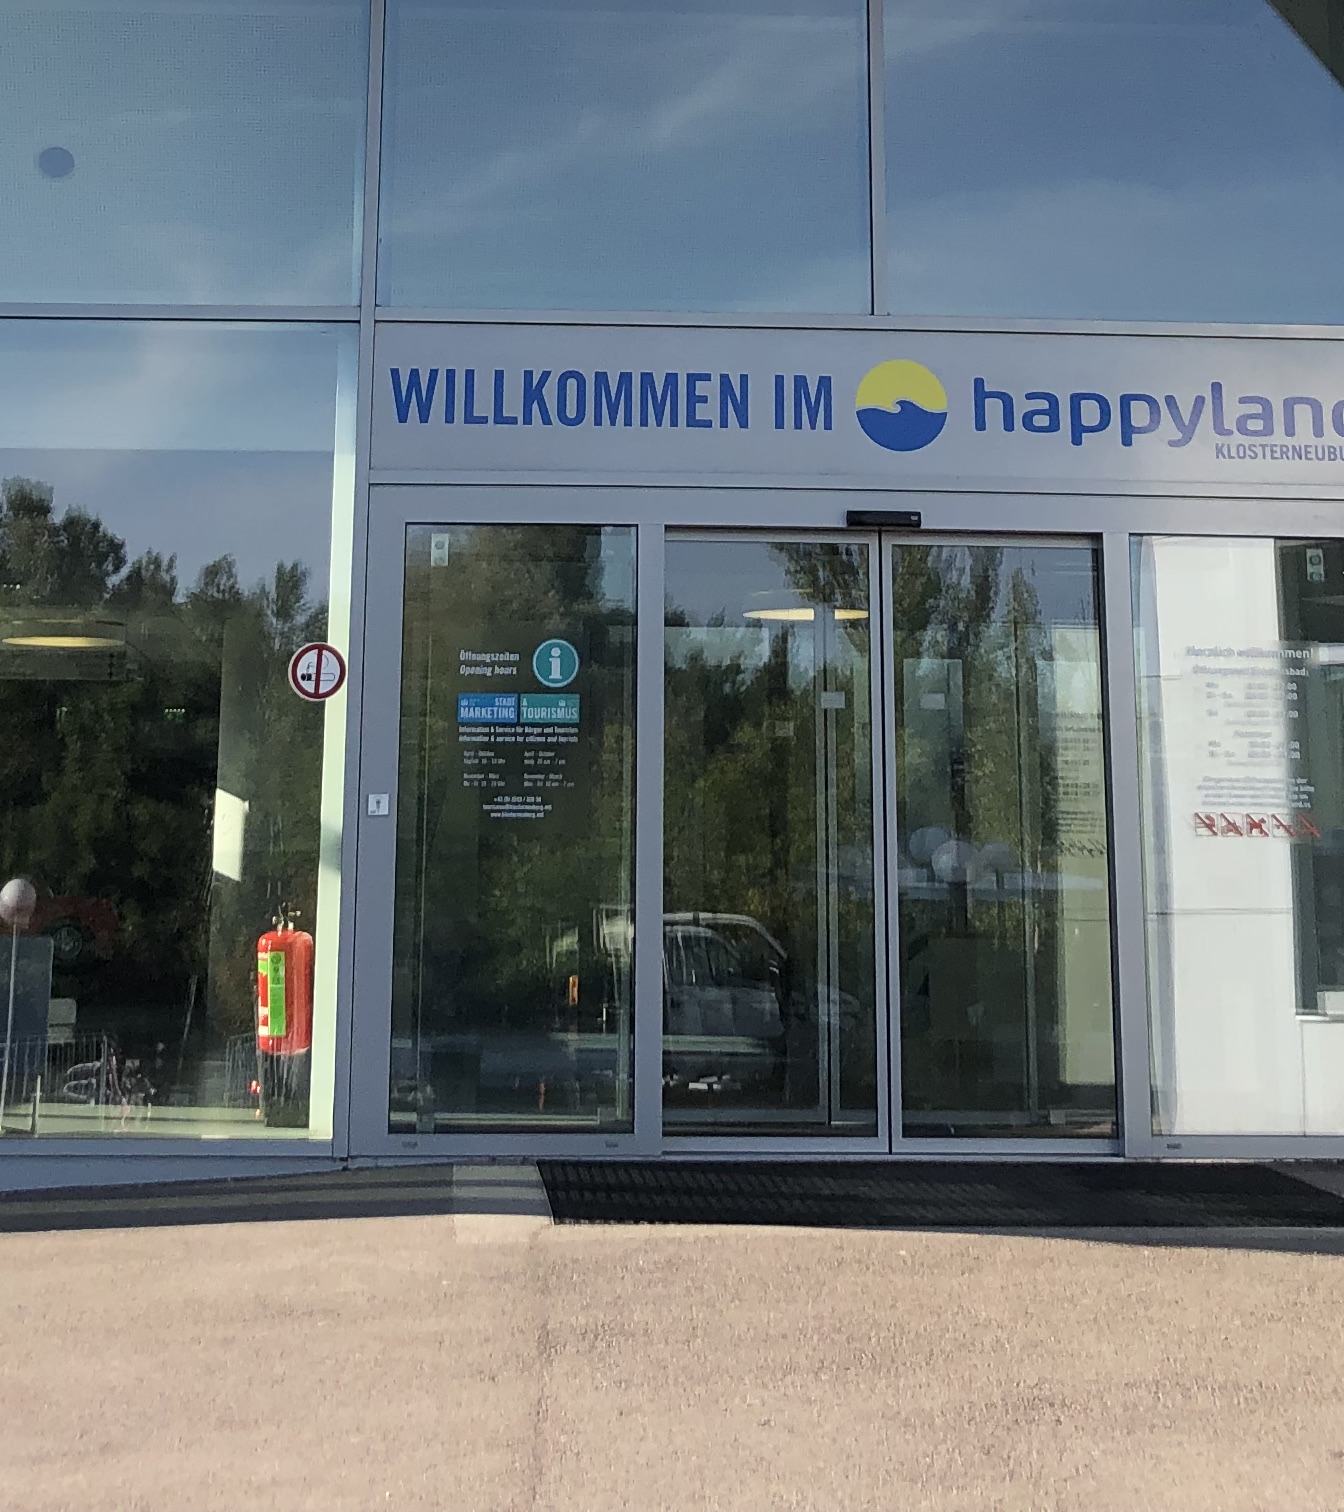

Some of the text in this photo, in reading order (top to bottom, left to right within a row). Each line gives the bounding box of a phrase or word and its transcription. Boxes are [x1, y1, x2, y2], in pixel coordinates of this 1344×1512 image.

[389, 367, 833, 432] WILLKOMMEN IM
[460, 664, 517, 676] Opening hours
[460, 707, 515, 719] MARKETING
[522, 707, 578, 719] TOURISMUS
